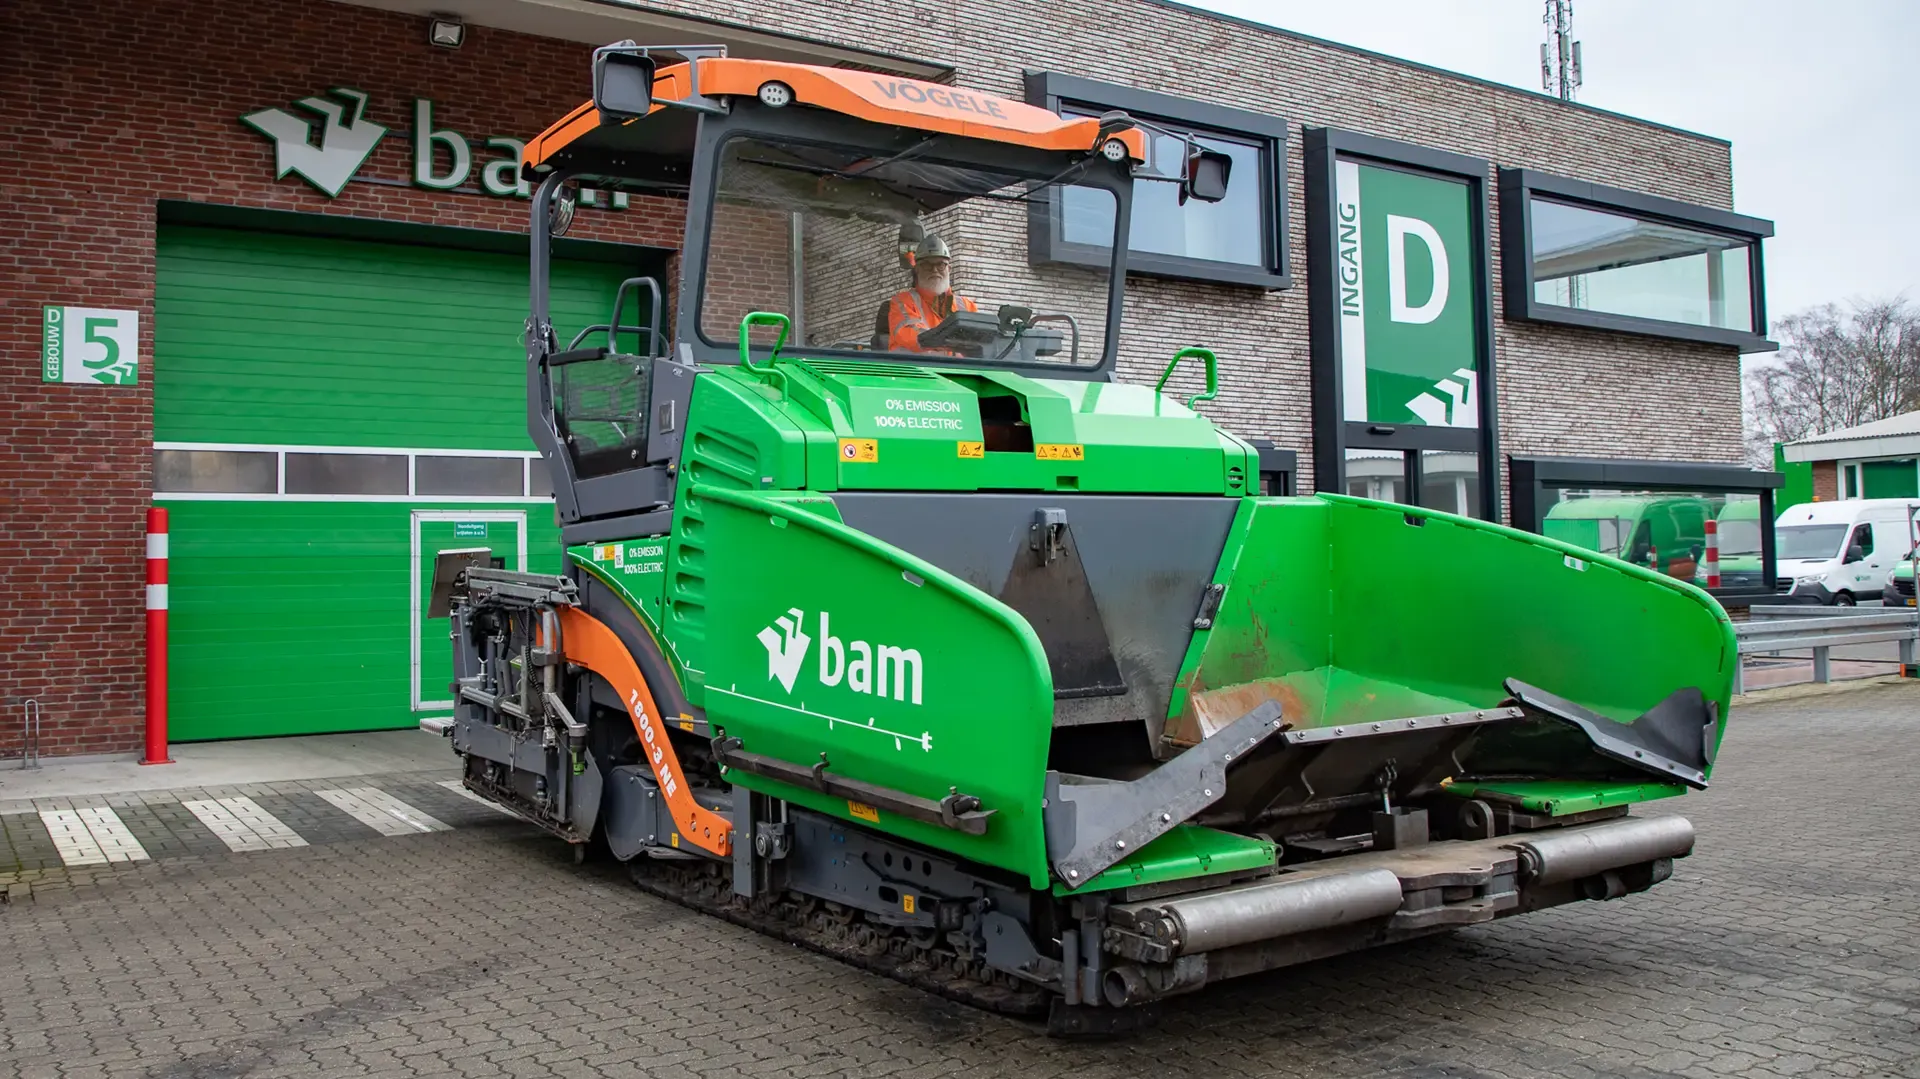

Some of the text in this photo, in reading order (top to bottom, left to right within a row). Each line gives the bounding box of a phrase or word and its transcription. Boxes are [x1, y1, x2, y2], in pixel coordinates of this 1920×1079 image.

[872, 79, 1008, 120] VÖGELE
[413, 98, 630, 209] ba
[1339, 202, 1360, 317] INGANG
[1387, 213, 1449, 325] D
[47, 308, 61, 379] GEBOUW D
[82, 317, 120, 370] 5
[874, 416, 963, 430] 100% ELECTRIC
[885, 399, 961, 413] 0% EMISSION
[637, 546, 664, 557] EMISSION
[637, 562, 664, 573] ELECTRIC
[819, 611, 923, 705] bam
[630, 688, 677, 798] 1800-3 NE
